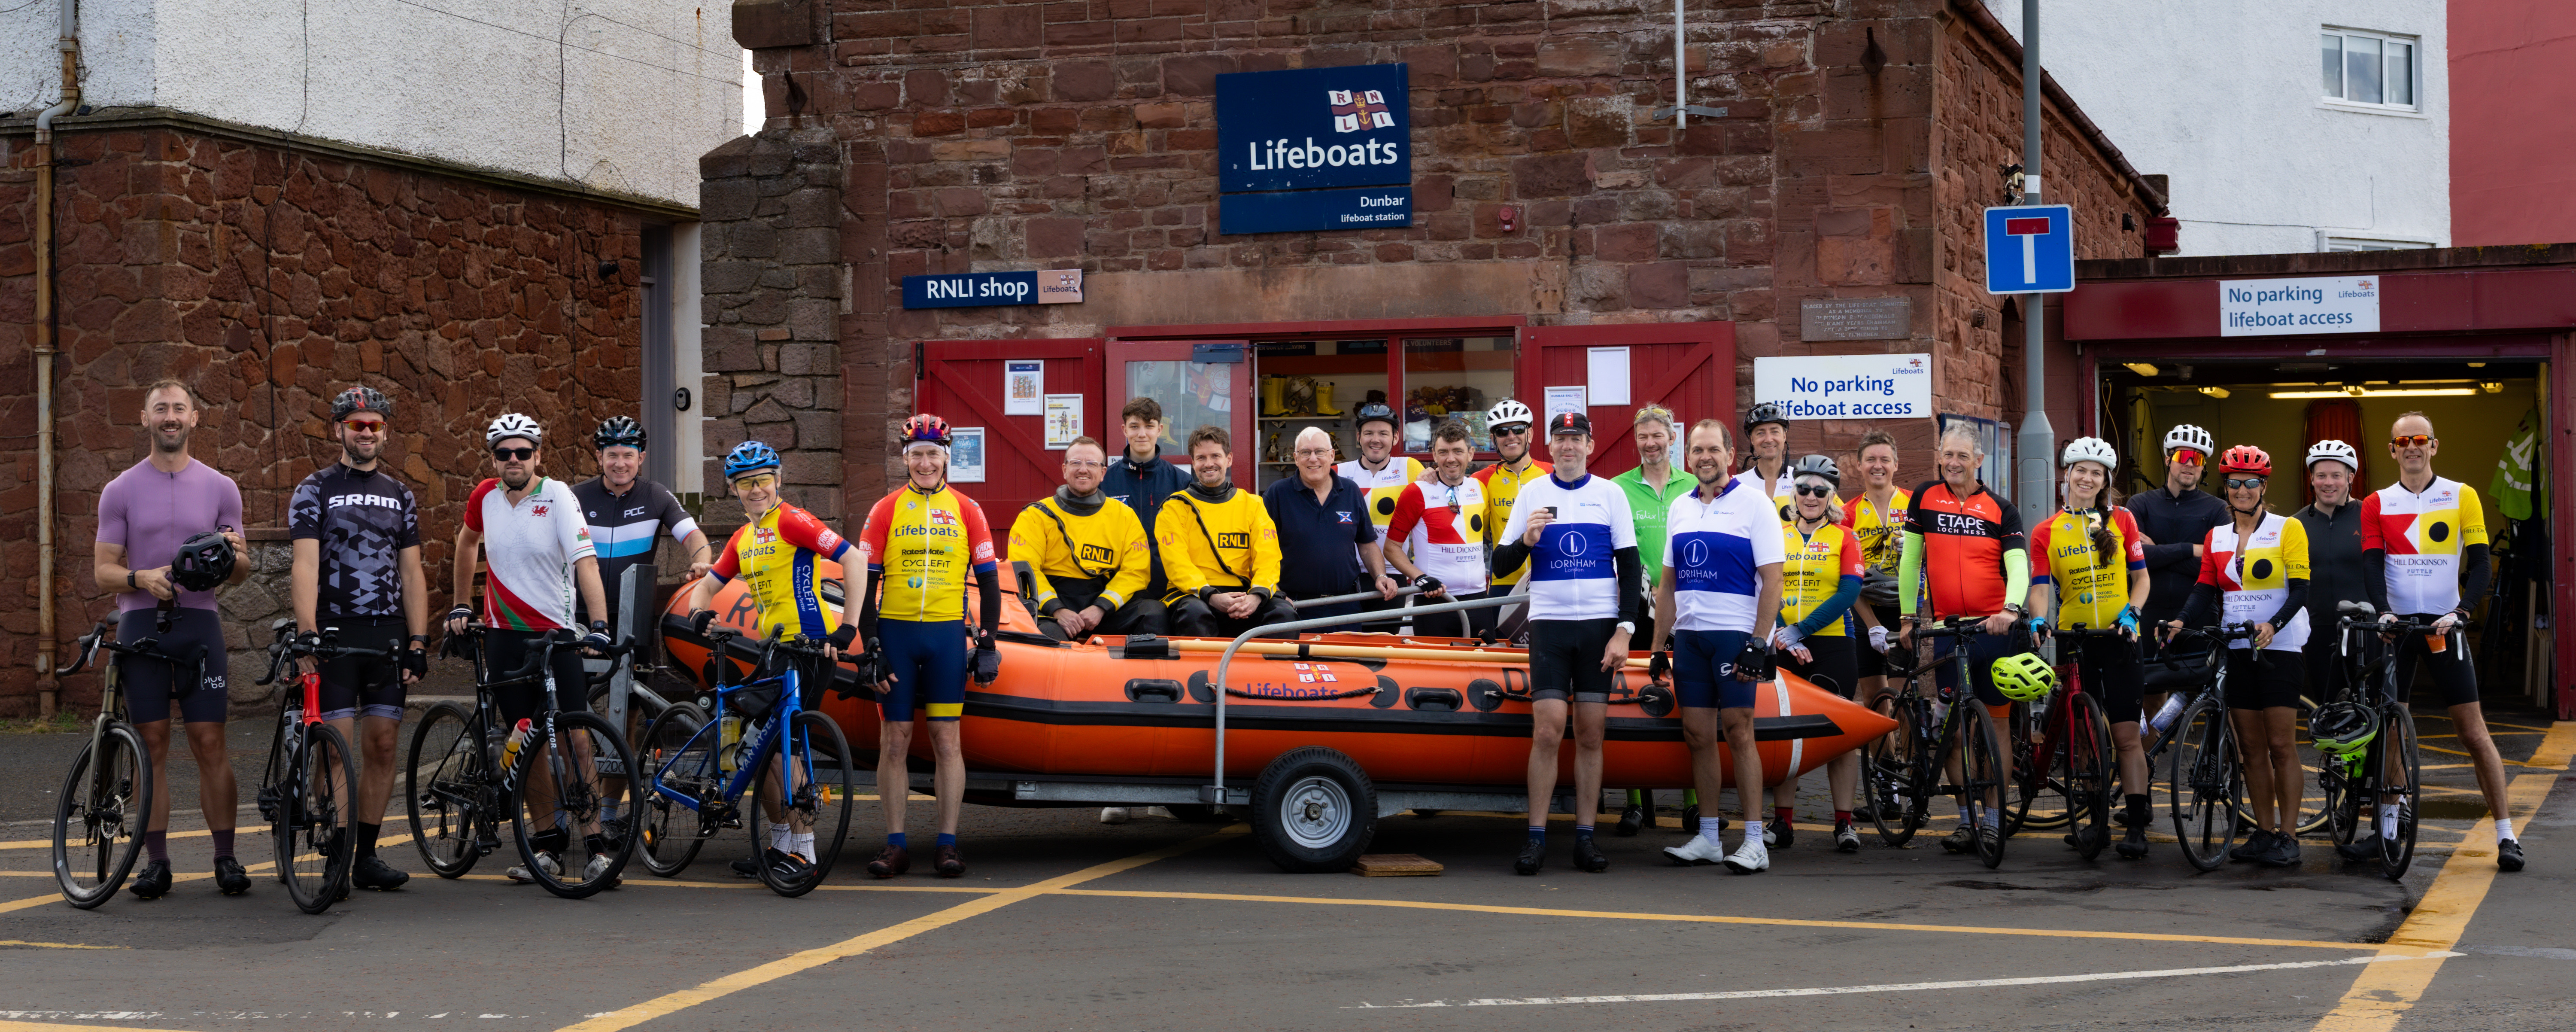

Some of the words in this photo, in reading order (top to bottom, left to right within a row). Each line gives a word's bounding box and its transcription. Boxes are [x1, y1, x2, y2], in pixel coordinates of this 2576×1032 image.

[1250, 137, 1397, 170] Lifeboats
[1361, 195, 1404, 207] Dunbar
[1341, 214, 1373, 222] lifeboat
[1375, 213, 1404, 221] station
[927, 279, 973, 298] RNLI
[980, 277, 1028, 301] shop
[2229, 288, 2252, 302] No
[2257, 286, 2322, 305] parking
[2230, 312, 2294, 327] lifeboat
[2299, 312, 2353, 325] access
[1792, 377, 1818, 393] No
[1825, 375, 1894, 397] parking
[1853, 402, 1912, 415] access
[329, 494, 402, 510] SRAM
[624, 506, 644, 518] PCC
[1636, 510, 1657, 520] Felix
[1938, 514, 1985, 531] ETAPE
[895, 524, 959, 537] Lifeboats
[1009, 535, 1026, 546] NLI
[1220, 535, 1248, 548] RNLI
[1082, 546, 1112, 563] RNLI
[1785, 552, 1828, 563] ifeboats
[2057, 544, 2098, 558] Lifebo
[1551, 559, 1596, 569] LORNHAM
[2069, 564, 2108, 575] RatesMate
[1678, 569, 1717, 579] LORNHAM
[2234, 594, 2272, 602] DICKINSON
[211, 680, 225, 689] ball
[1247, 683, 1338, 702] Lifeboats
[547, 718, 558, 749] FACTOR
[740, 750, 755, 773] VAN
